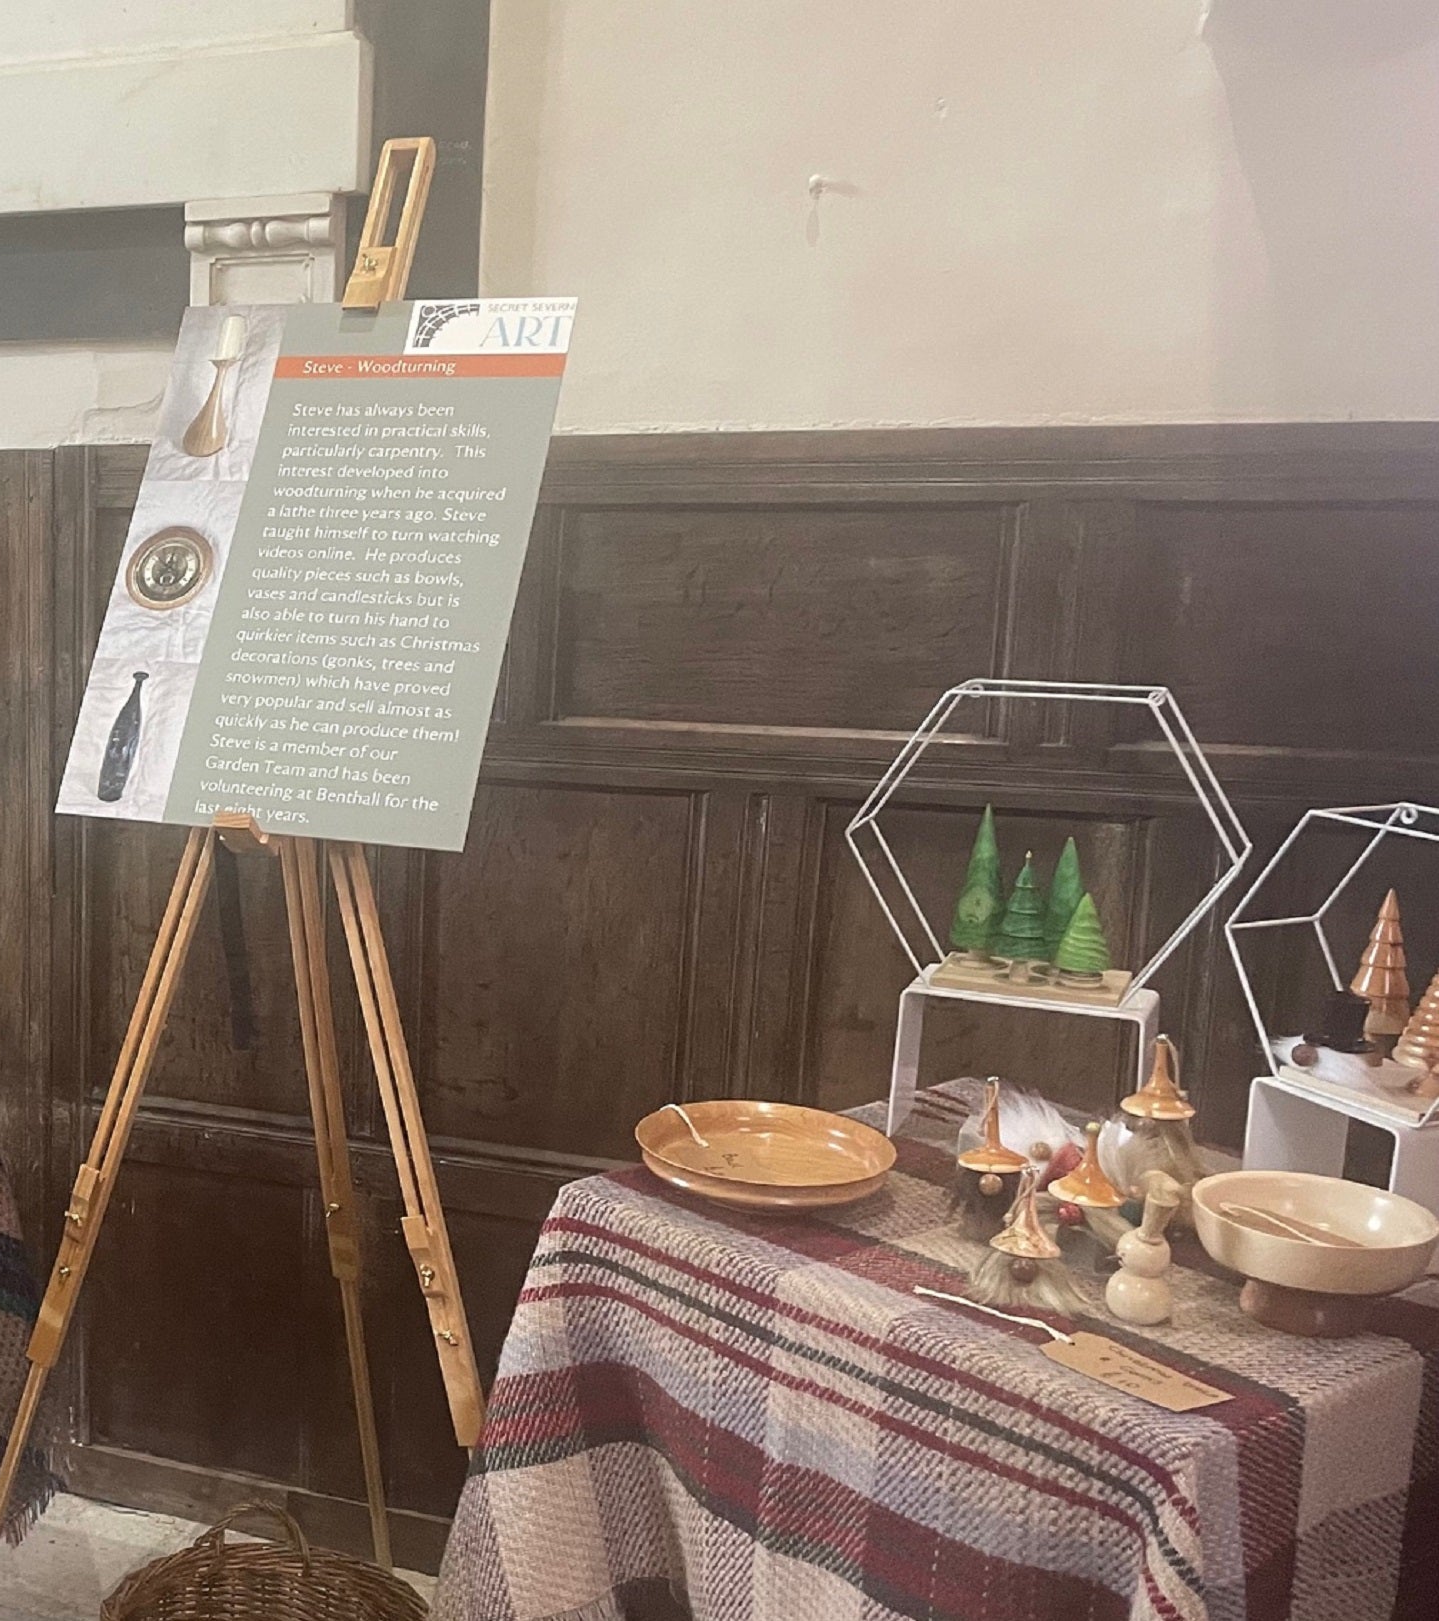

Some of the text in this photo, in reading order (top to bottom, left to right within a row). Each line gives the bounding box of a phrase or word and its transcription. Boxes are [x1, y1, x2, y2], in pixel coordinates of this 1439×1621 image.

[488, 303, 527, 312] SECRET
[479, 316, 572, 347] ART
[303, 361, 342, 373] Steve
[359, 361, 455, 374] Woodturning
[293, 403, 454, 418] Steve has always been
[288, 424, 490, 439] interested in practical skills,
[282, 444, 486, 460] particularly carpentry. This
[278, 464, 448, 480] interest developed into
[274, 485, 506, 503] woodturning when he acquired
[267, 504, 486, 523] a lathe three years ago. Steve
[263, 526, 500, 547] taught himself to turn watching
[259, 546, 462, 564] videos online. He produces
[252, 567, 463, 588] quality pieces such as bowls,
[248, 588, 460, 607] vases and candlesticks but is
[242, 607, 449, 628] also able to turn his hand to
[236, 628, 480, 653] quirkier items such as Christmas
[231, 648, 455, 673] decorations (gonks, trees and
[225, 673, 451, 696] snowmen) which have proved
[222, 694, 452, 718] very popular and sell almost as
[215, 713, 459, 742] quickly as he can produce them!
[210, 734, 398, 760] Steve is a member of our
[206, 756, 410, 785] Garden Team and has been
[200, 779, 439, 811] volunteering at Benthall for the
[194, 800, 220, 814] last
[266, 810, 309, 823] years.
